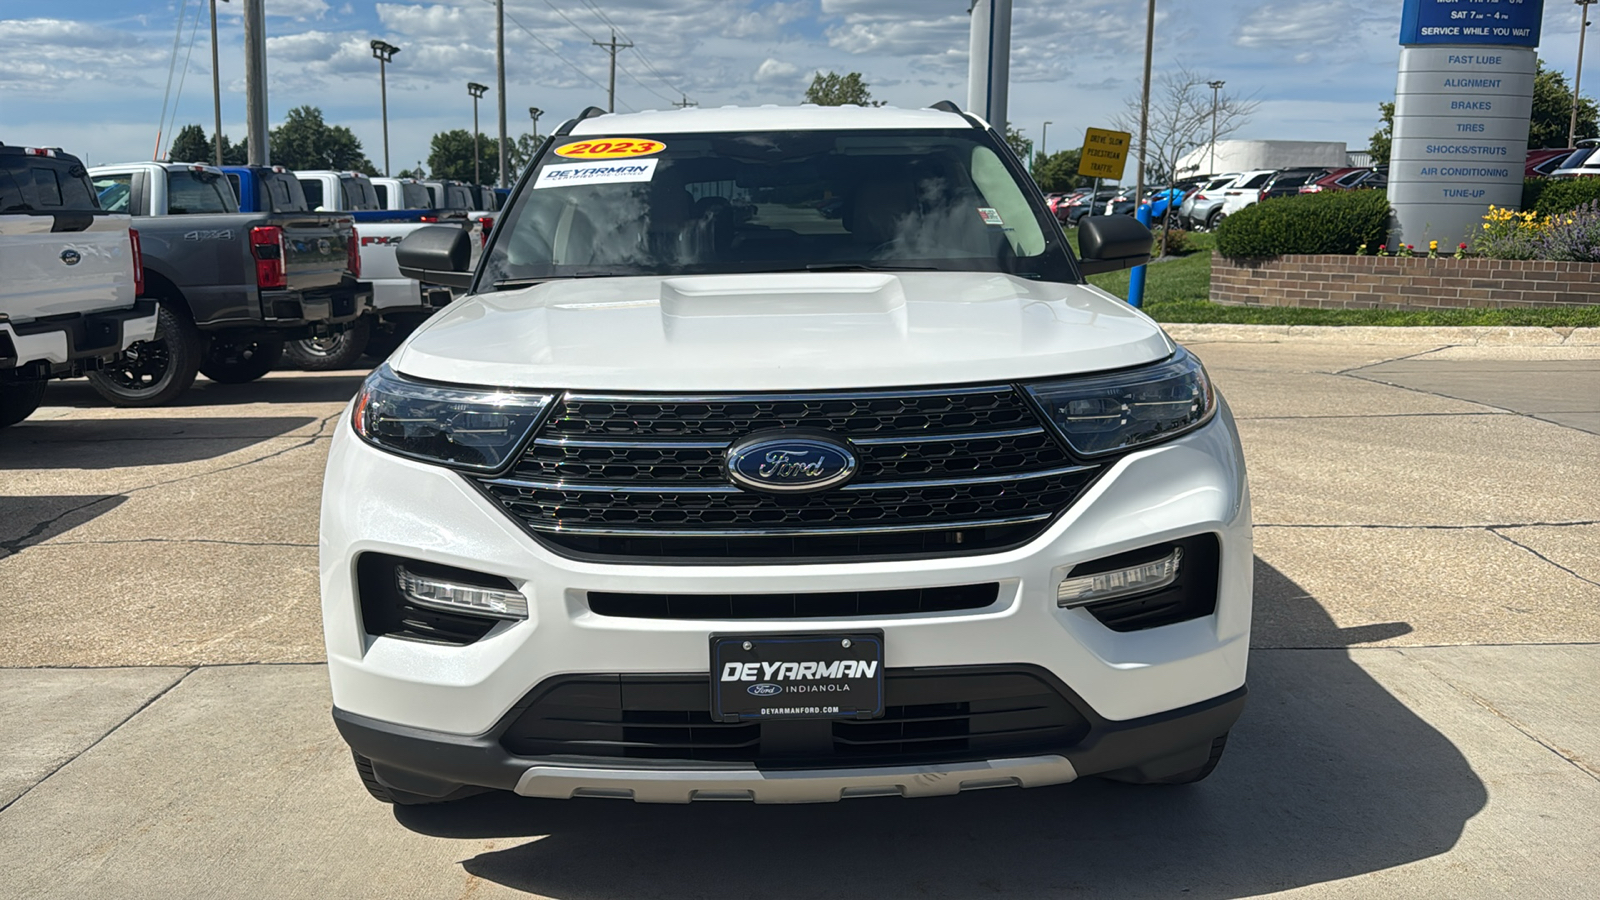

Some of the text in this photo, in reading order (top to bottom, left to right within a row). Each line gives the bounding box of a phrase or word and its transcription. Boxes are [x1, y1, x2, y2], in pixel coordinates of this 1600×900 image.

[1450, 11, 1467, 19] SAT
[1421, 27, 1531, 37] SERVICE WHILE YOU WAIT
[1448, 55, 1502, 65] FAST LUBE
[1443, 78, 1502, 88] ALIGNMENT
[1450, 101, 1492, 111] BRAKES
[1456, 123, 1485, 132] TIRES
[1090, 135, 1123, 146] DRIVE SLOW
[564, 142, 656, 155] 2023
[1426, 145, 1507, 156] SHOCKS/STRUTS
[1087, 148, 1121, 160] PEDESTRIAN
[546, 165, 649, 178] DEYARMAN
[1090, 162, 1113, 173] TRAFFIC
[1420, 167, 1508, 178] AIR CONDITIONING
[1443, 189, 1485, 198] TUNE-UP
[759, 449, 825, 478] Ford
[720, 660, 878, 682] DEYARMAN
[786, 684, 850, 693] INDIANOLA
[761, 706, 839, 715] DEYARMANFORD.COM
